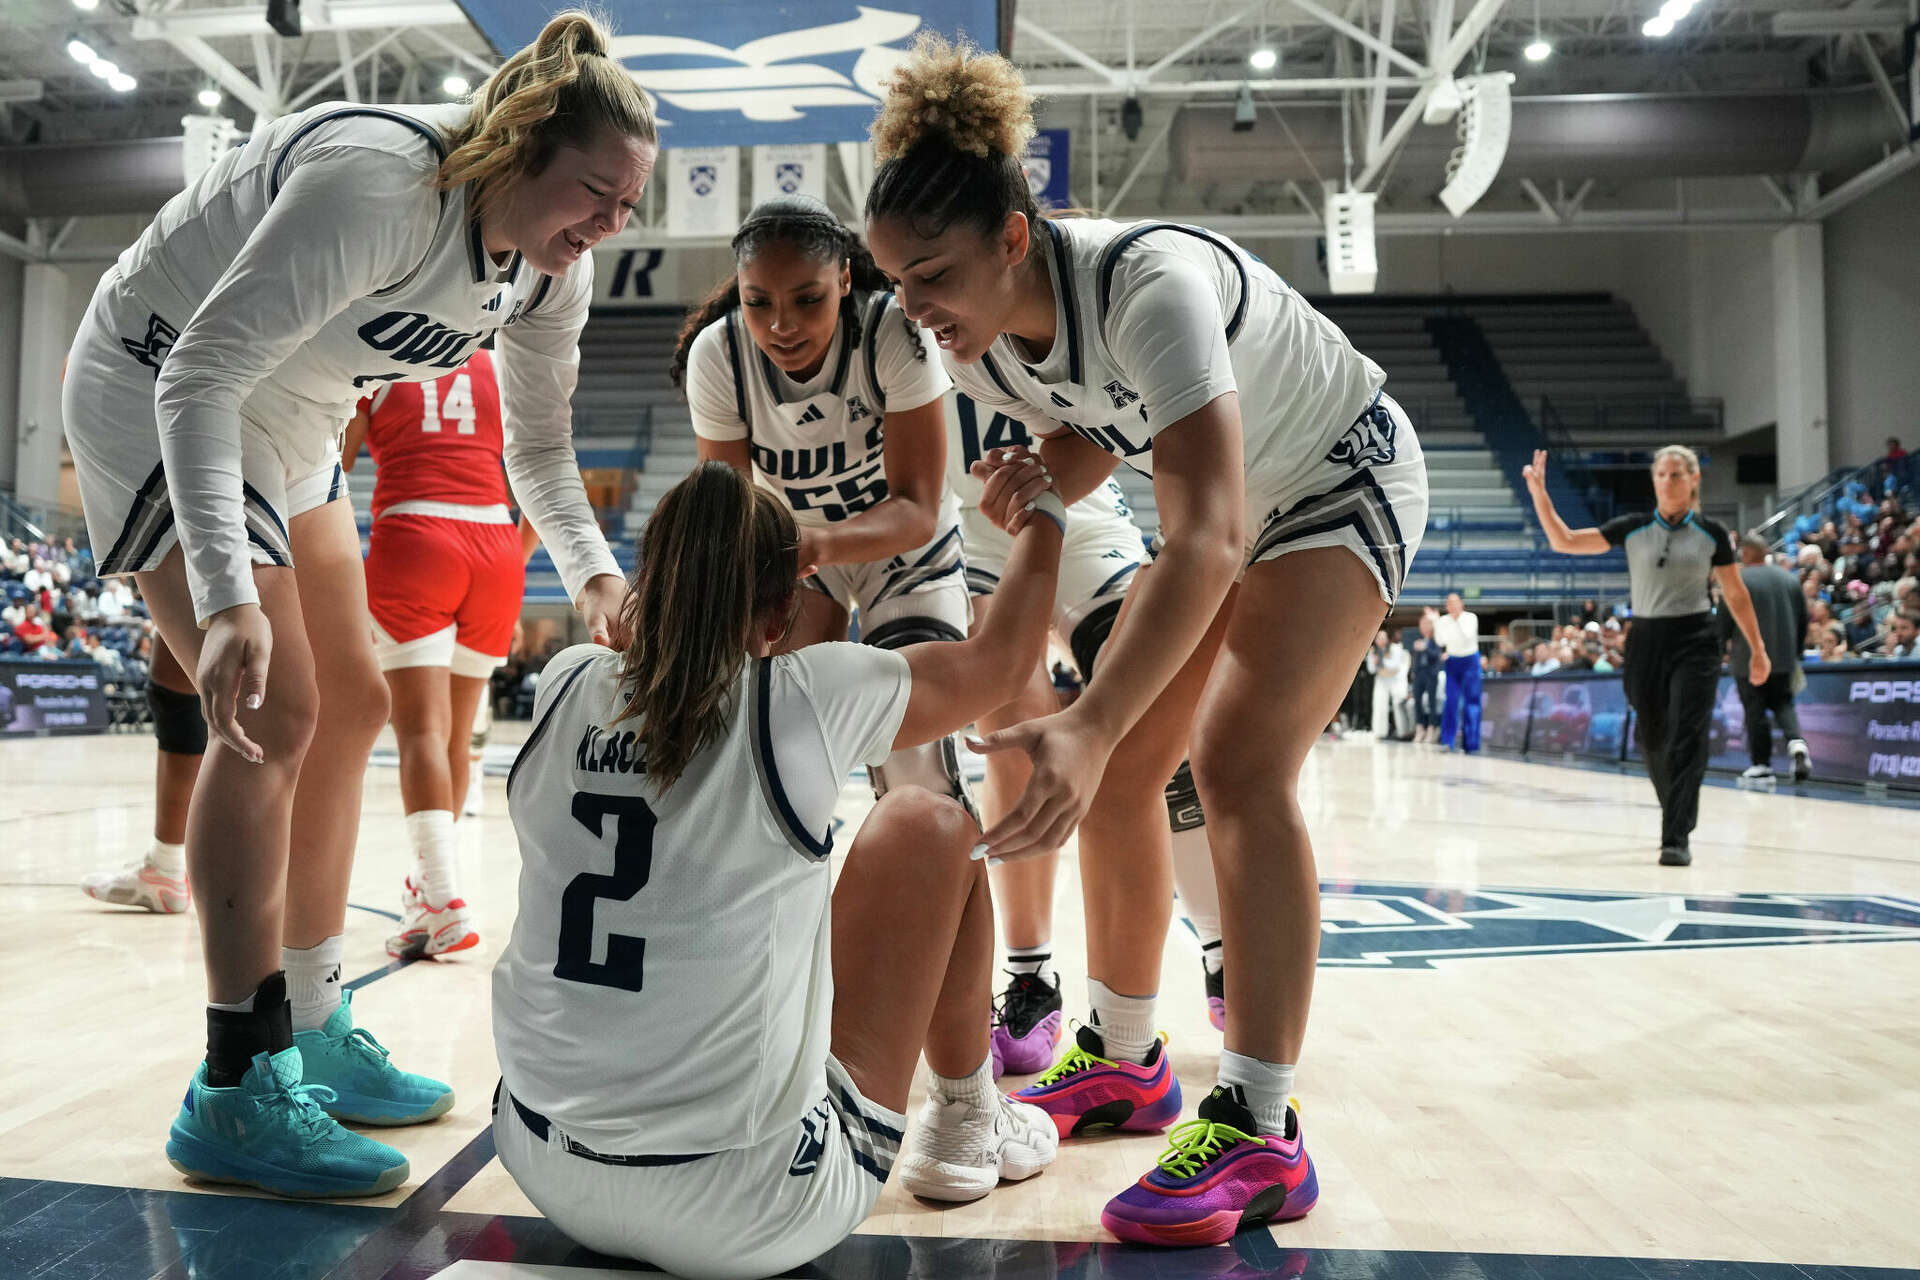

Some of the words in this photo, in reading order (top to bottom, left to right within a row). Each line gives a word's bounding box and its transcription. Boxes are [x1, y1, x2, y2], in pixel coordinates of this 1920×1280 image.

[609, 248, 665, 298] R
[357, 311, 483, 369] OWL
[420, 373, 477, 434] 14
[956, 391, 1033, 474] 14
[784, 463, 889, 522] 55
[553, 791, 658, 992] 2
